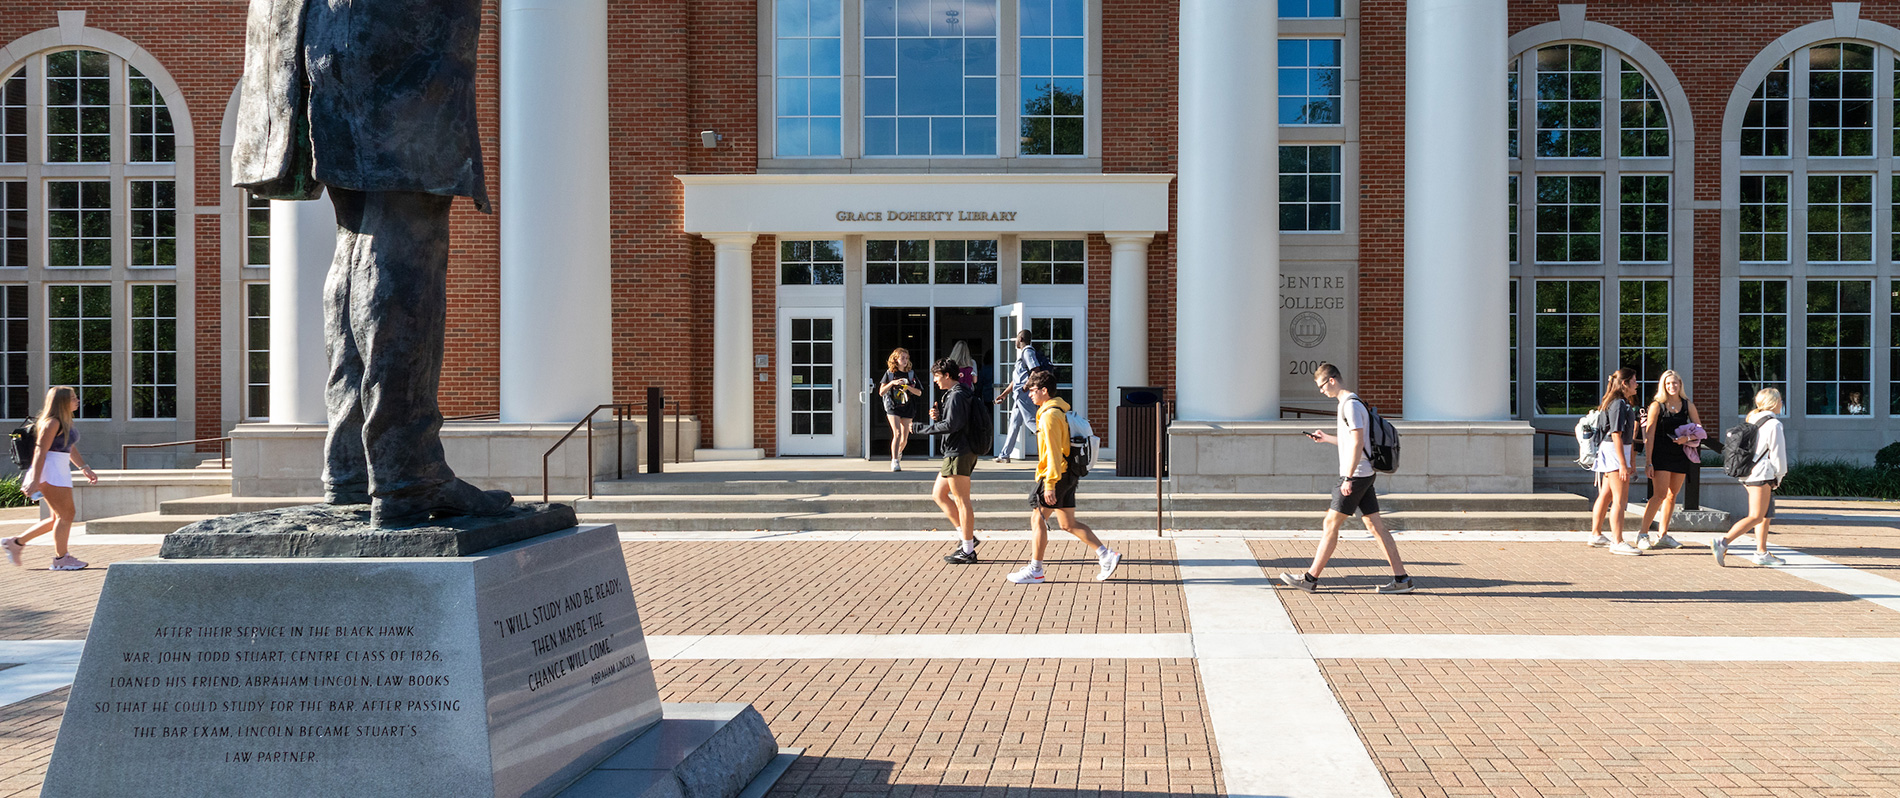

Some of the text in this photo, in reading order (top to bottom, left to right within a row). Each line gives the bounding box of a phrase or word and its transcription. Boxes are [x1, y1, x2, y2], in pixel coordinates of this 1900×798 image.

[835, 210, 1018, 222] GRACE DOHERTY LIBRARY
[1289, 360, 1327, 375] 200
[505, 611, 532, 635] WILL
[532, 599, 562, 626] STUDY
[565, 592, 582, 613] AND
[583, 587, 595, 604] BE
[154, 625, 415, 638] AFTER THEIR SERVICE IN THE BLACK HAWK
[531, 612, 605, 657] THEN MAYBE THE
[157, 651, 192, 665] JOHN
[197, 651, 230, 663] TODD
[290, 650, 341, 662] CENTRE
[345, 650, 385, 662] CLASS
[390, 650, 407, 662] OF
[528, 659, 567, 692] CHANCE
[566, 649, 589, 672] WILL
[591, 653, 636, 687] ABRAHAM LINCOLN
[110, 676, 161, 688] LOANED
[165, 676, 187, 688] HIS
[245, 676, 309, 687] ABRAHAM
[376, 675, 404, 687] LAW
[408, 674, 450, 687] BOOKS
[94, 701, 110, 713] SO
[116, 701, 148, 713] THAT
[152, 701, 169, 713] HE
[174, 701, 218, 713] COULD
[222, 700, 265, 712] STUDY
[270, 701, 294, 712] FOR
[299, 700, 323, 712] THE
[361, 700, 402, 712] AFTER
[407, 699, 461, 711] PASSING
[133, 727, 157, 738] THE
[162, 727, 188, 738] BAR
[238, 726, 294, 738] LINCOLN
[299, 725, 351, 738] BECAME
[356, 724, 418, 737] STUART'S
[225, 752, 253, 763] LAW
